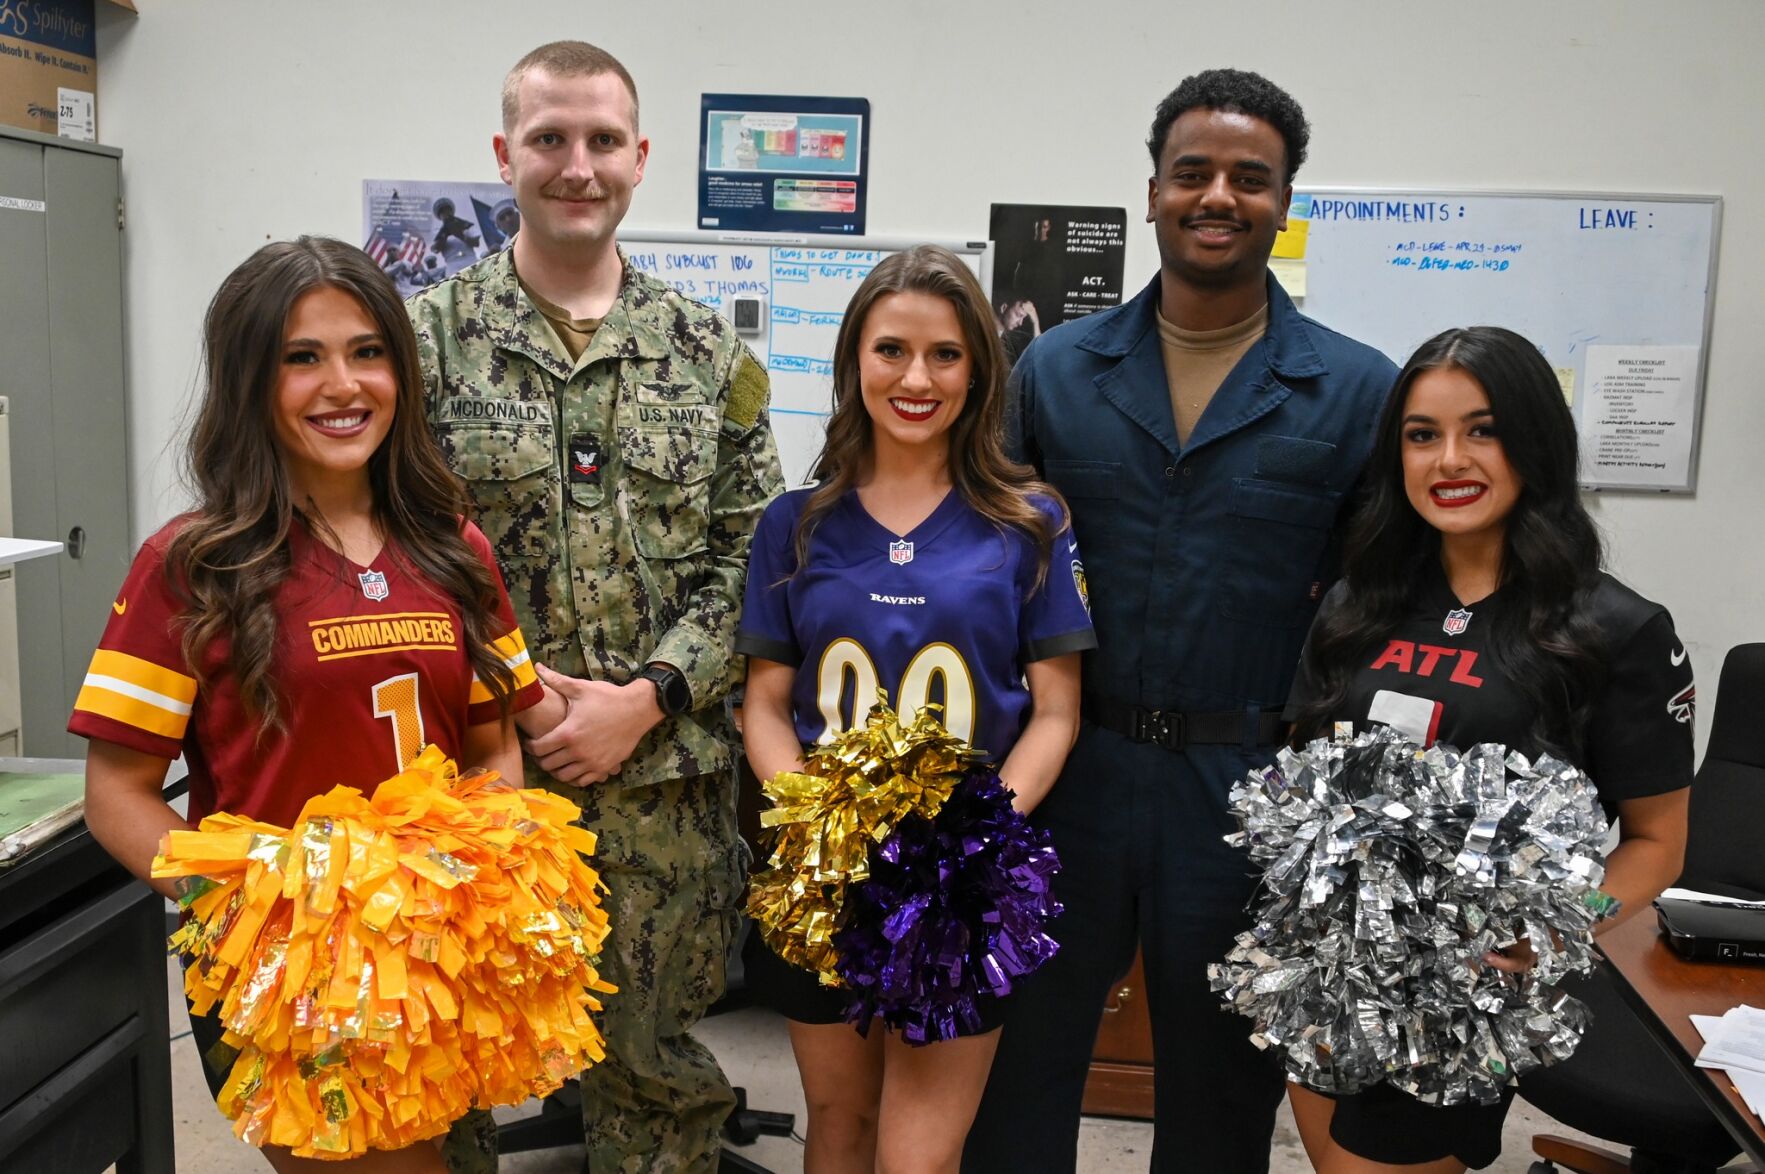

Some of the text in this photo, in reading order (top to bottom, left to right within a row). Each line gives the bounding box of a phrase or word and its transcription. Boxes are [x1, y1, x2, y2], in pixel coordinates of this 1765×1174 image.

[33, 3, 88, 40] Spilfyter
[60, 105, 73, 118] Z-75
[1068, 221, 1121, 230] Warning signs
[1081, 238, 1107, 246] always
[1109, 238, 1123, 246] this
[820, 250, 839, 260] GET
[1082, 276, 1106, 286] ACT.
[704, 280, 770, 296] THOMAS
[450, 400, 538, 420] MCDONALD
[639, 407, 704, 424] U.S. NAVY
[892, 550, 910, 561] NFL
[367, 582, 386, 596] NFL
[869, 592, 926, 605] RAVENS
[1446, 618, 1464, 631] NFL
[312, 619, 456, 654] COMMANDERS
[1370, 639, 1485, 689] ATL
[371, 671, 426, 775] 1
